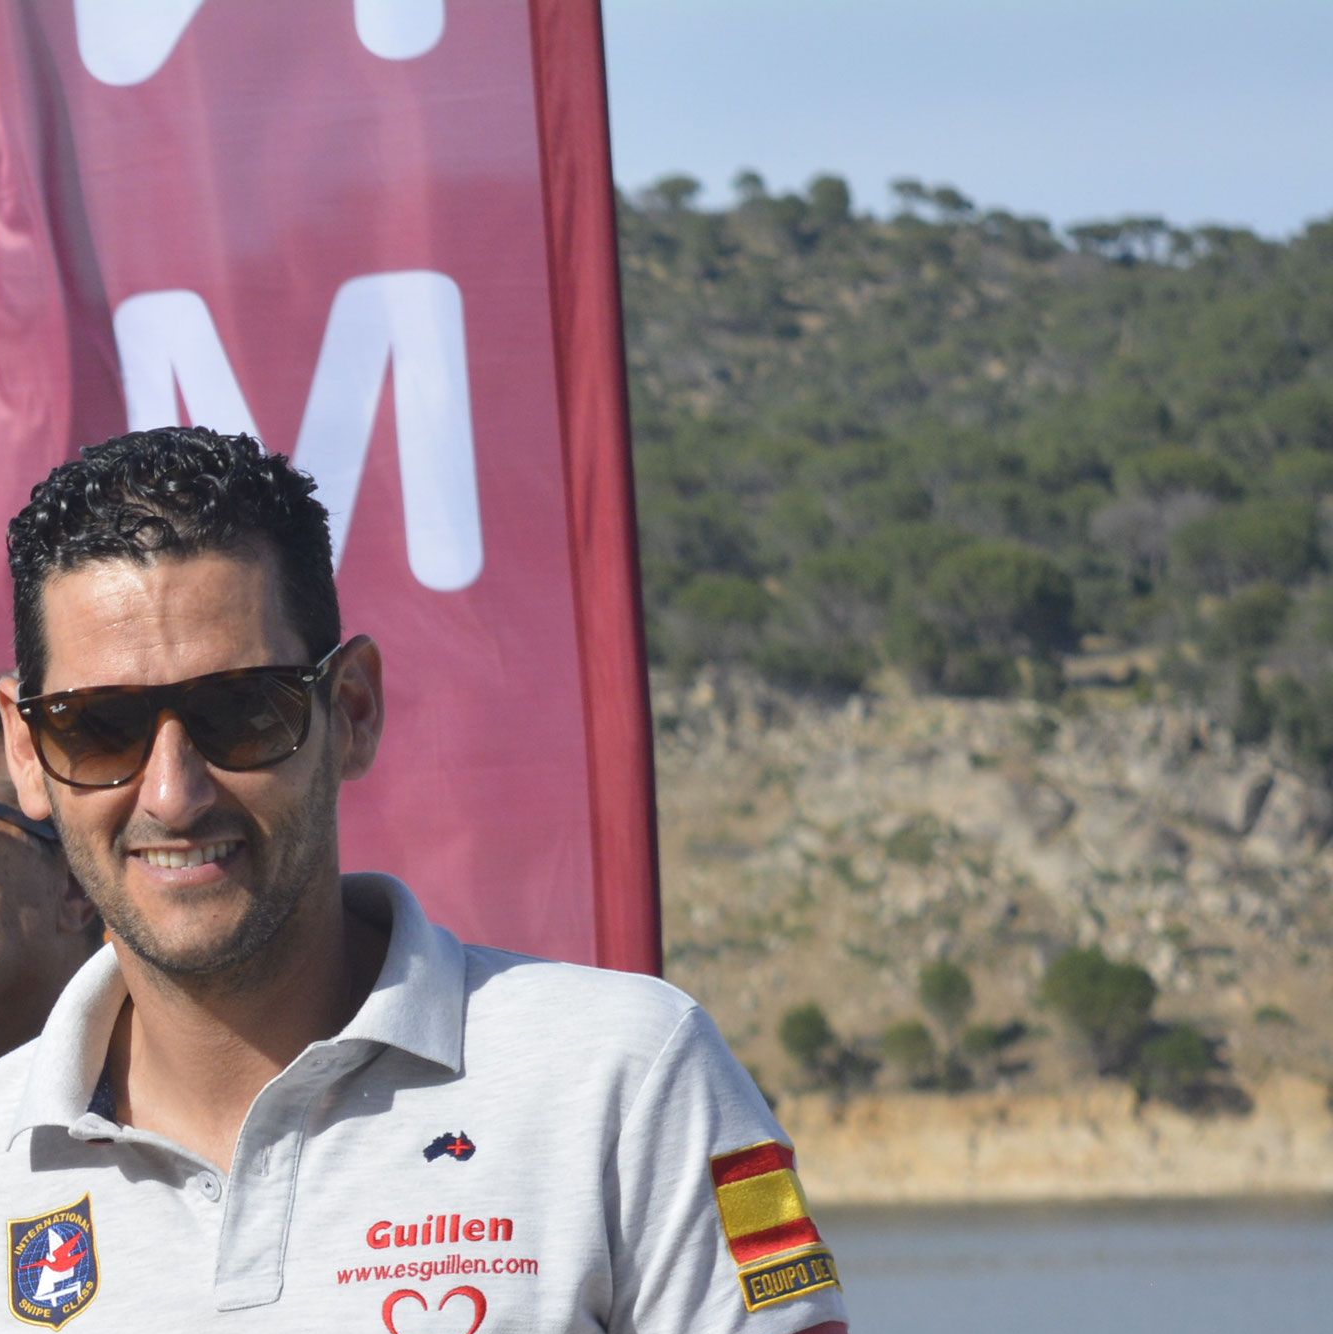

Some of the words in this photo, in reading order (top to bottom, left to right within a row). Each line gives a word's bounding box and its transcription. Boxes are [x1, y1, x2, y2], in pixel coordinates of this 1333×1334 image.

[14, 1212, 90, 1256] INTERNATIONAL
[366, 1213, 514, 1249] Guillen
[337, 1254, 539, 1285] www.esguillen.com
[750, 1262, 811, 1300] EQUIPO
[810, 1258, 830, 1281] DE
[18, 1298, 52, 1318] SNIPE
[62, 1280, 94, 1314] CLASS
